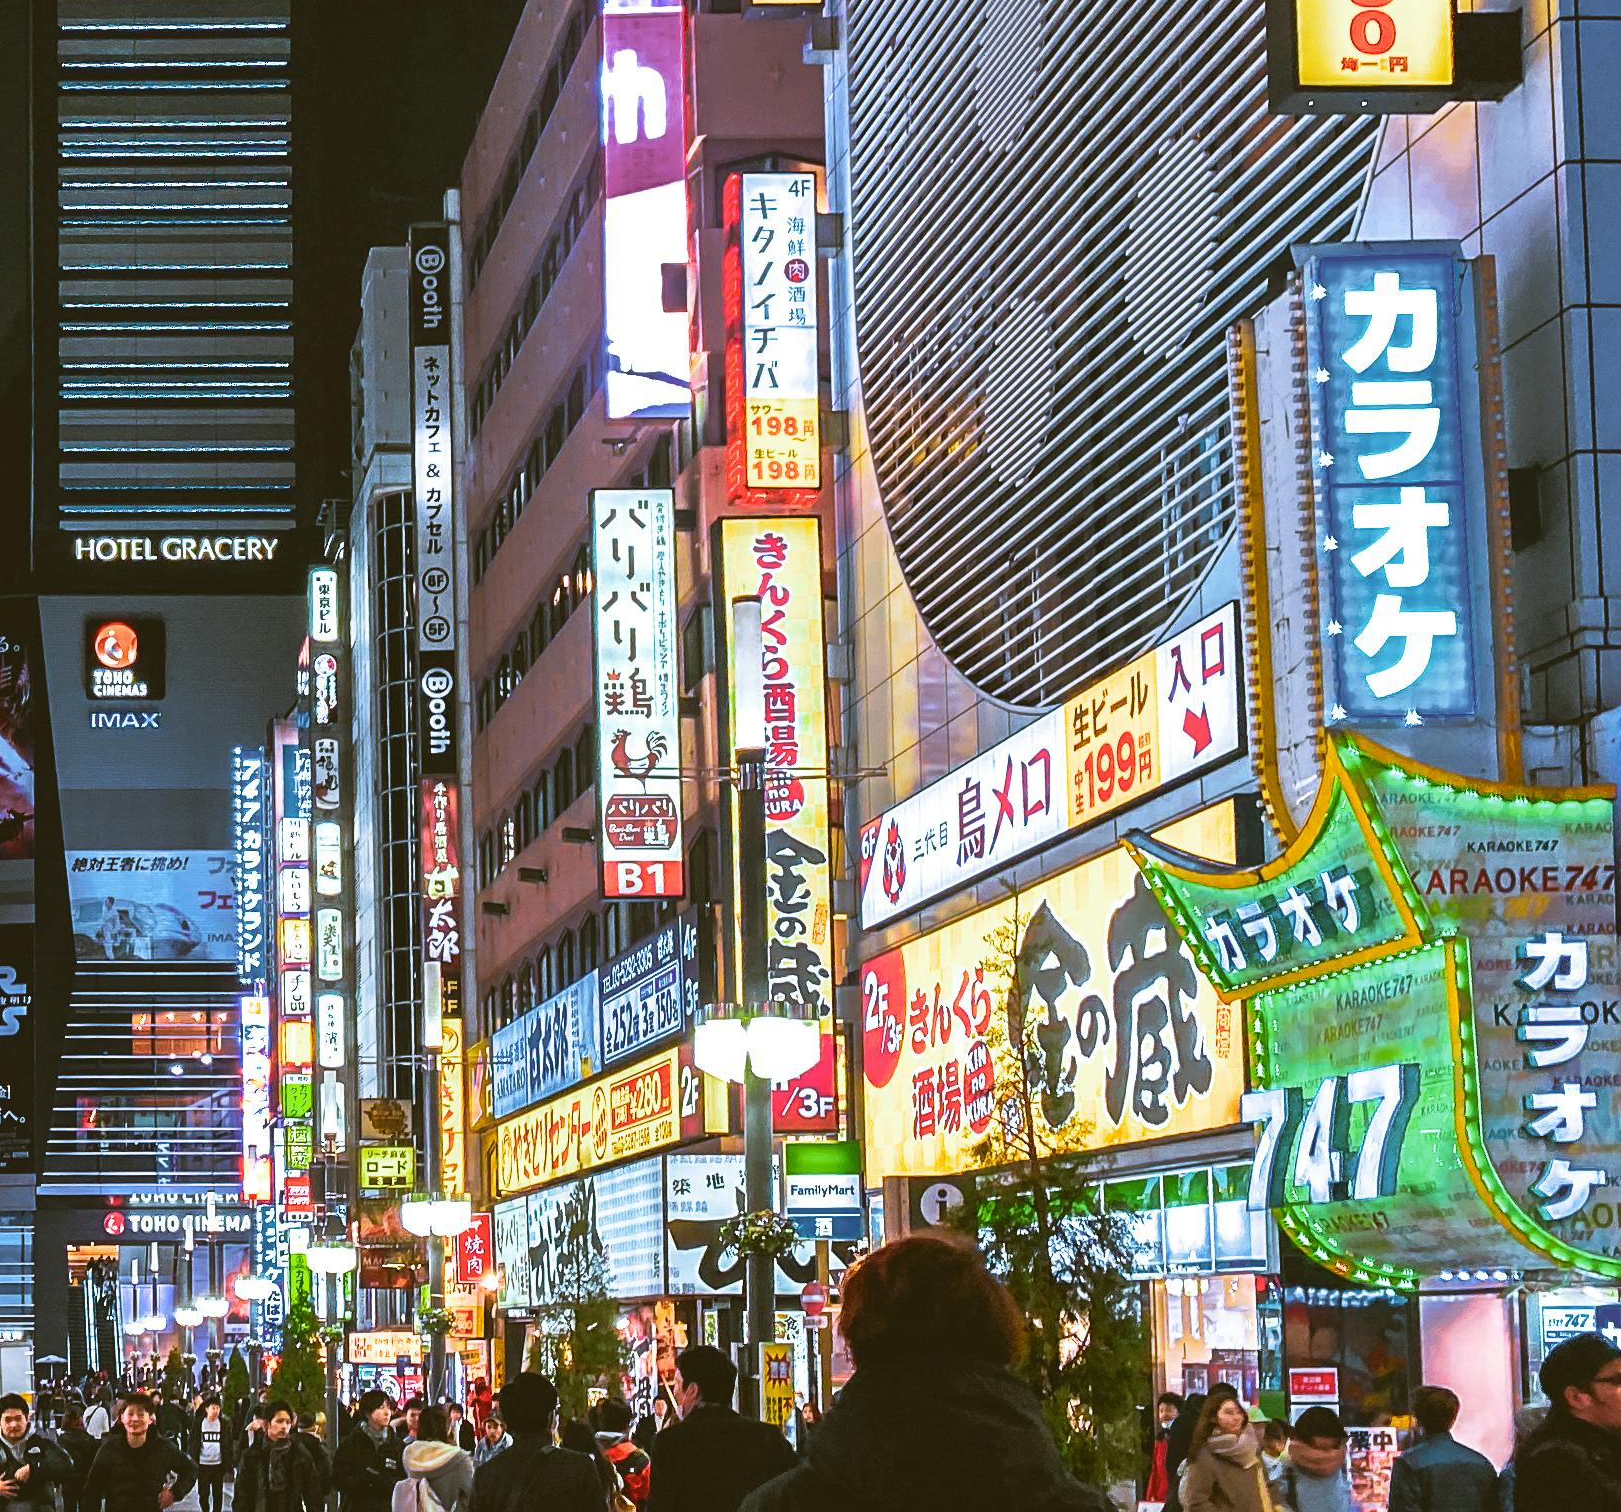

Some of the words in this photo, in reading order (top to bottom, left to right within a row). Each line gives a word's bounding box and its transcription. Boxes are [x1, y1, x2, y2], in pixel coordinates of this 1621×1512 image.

[788, 179, 810, 198] 4F
[416, 246, 445, 329] Booth
[749, 192, 780, 390] キタノイチバ
[423, 356, 442, 454] ネットカフェ
[751, 404, 783, 416] サワー
[426, 463, 441, 478] &
[753, 461, 816, 480] 198円
[754, 448, 799, 459] 生ビール
[1342, 272, 1458, 698] カラオケ
[426, 488, 444, 555] カプセル
[75, 538, 157, 561] HOTEL
[162, 538, 278, 561] GRACERY
[318, 583, 331, 634] 東京ビル
[93, 671, 133, 684] TOHO
[1168, 622, 1225, 704] 入口
[93, 685, 148, 697] CINEMAS
[90, 712, 159, 728] IMAX
[421, 667, 453, 754] Booth
[1072, 671, 1149, 752] 生ビール
[241, 760, 261, 823] 747
[956, 747, 1051, 868] 鳥メロ
[861, 831, 876, 864] 6F
[913, 822, 948, 862] 三代目
[1466, 840, 1559, 853] KARAOKE747
[72, 857, 189, 872] 絶対王者に挑め!
[616, 864, 665, 894] B1
[242, 829, 262, 975] カラオケランド
[1204, 869, 1360, 975] カラオケ
[684, 924, 697, 960] 4F
[685, 978, 699, 1016] 3F
[864, 971, 888, 1030] 2F
[910, 969, 991, 1054] きんくら
[1007, 871, 1213, 1129] 金の蔵
[1336, 974, 1413, 1013] KARAOKE747
[966, 1041, 987, 1074] KIN
[681, 1066, 699, 1118] 2F
[1526, 933, 1606, 1222] カラオケ
[912, 1061, 960, 1140] 酒場
[965, 1094, 994, 1124] KURA
[1241, 1064, 1405, 1211] 747
[367, 1161, 407, 1173] ロード
[790, 1185, 855, 1197] FamilyMart
[129, 1215, 178, 1233] TOHO
[815, 1218, 832, 1237] 酒
[465, 1236, 484, 1274] 焼肉
[1565, 1314, 1589, 1327] 747
